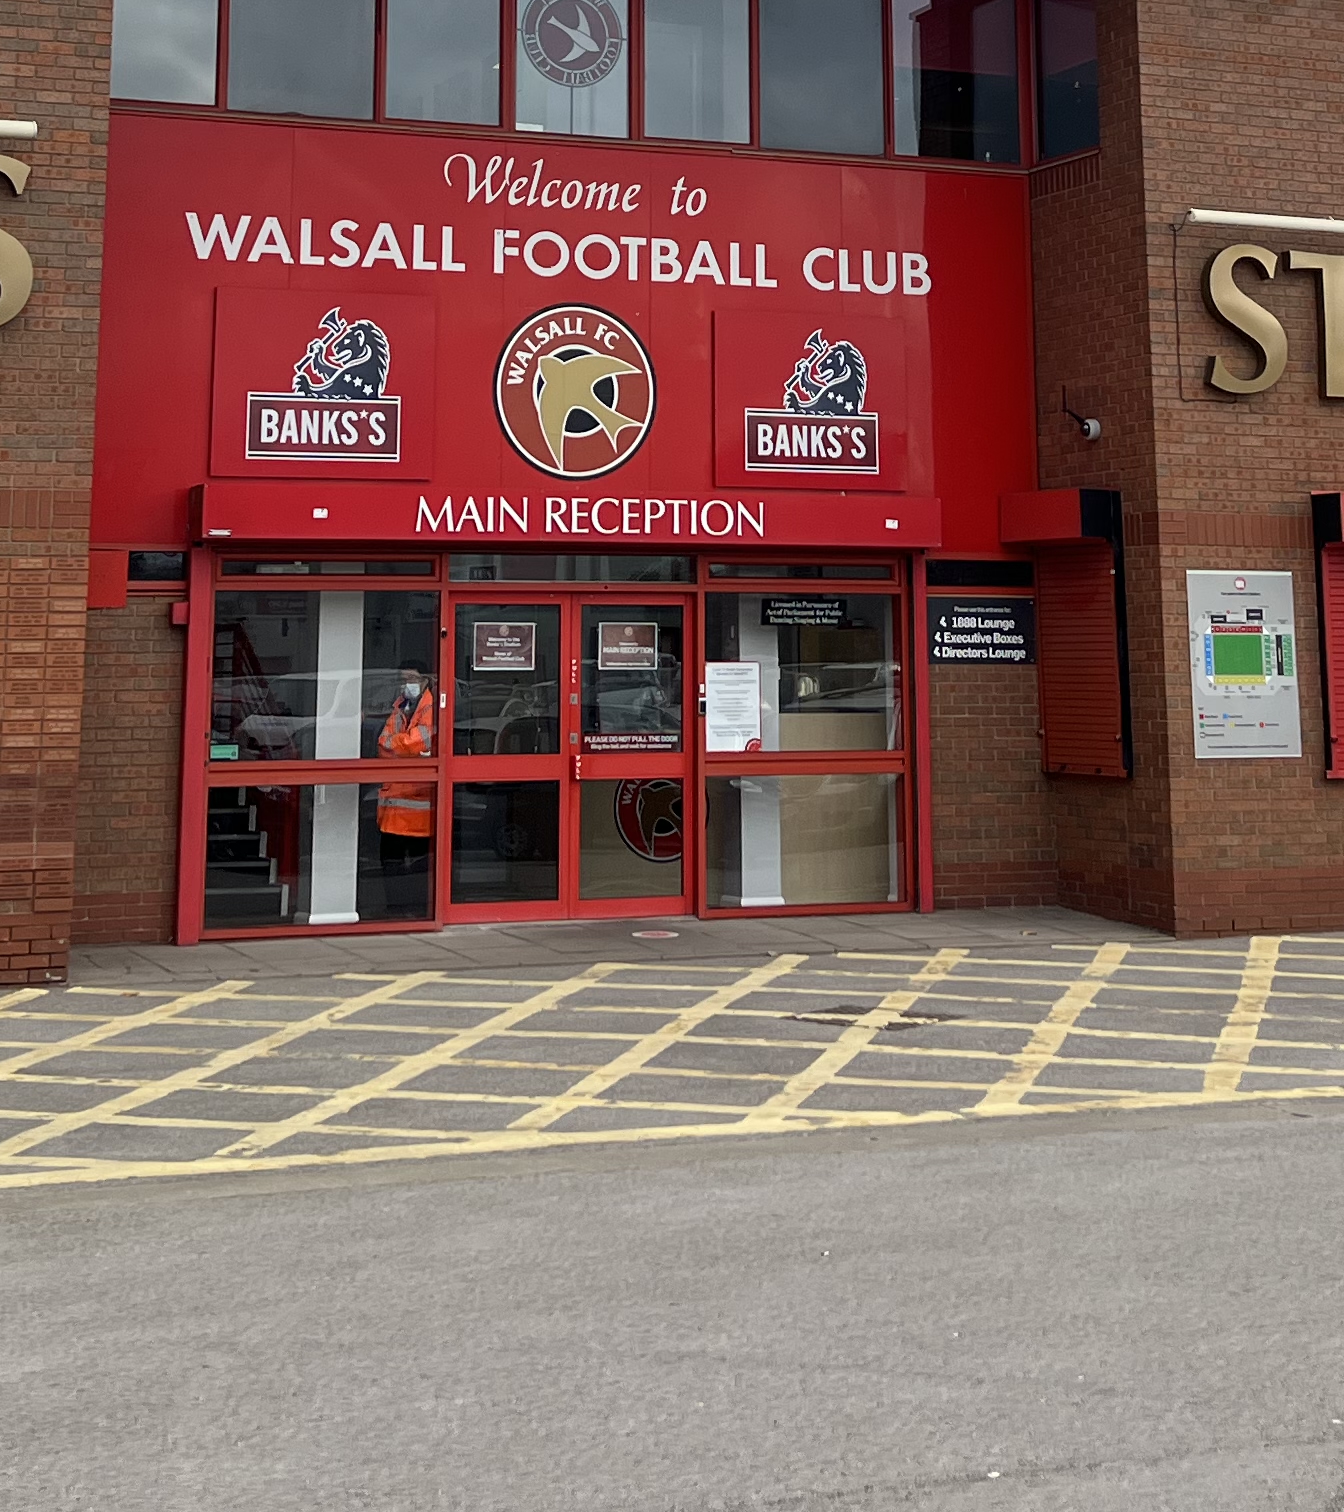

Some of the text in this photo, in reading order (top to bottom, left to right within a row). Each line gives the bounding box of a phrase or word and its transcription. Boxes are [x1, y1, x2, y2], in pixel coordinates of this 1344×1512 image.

[444, 153, 707, 216] Welcome to
[185, 211, 932, 296] WALSALL FOOTBALL CLUB
[506, 317, 620, 385] WALSALL FC
[415, 495, 764, 537] MAIN RECEPTION
[943, 632, 1024, 644] Executive Boxes
[978, 616, 1016, 631] Lounge
[942, 646, 1027, 661] Directors Lounge
